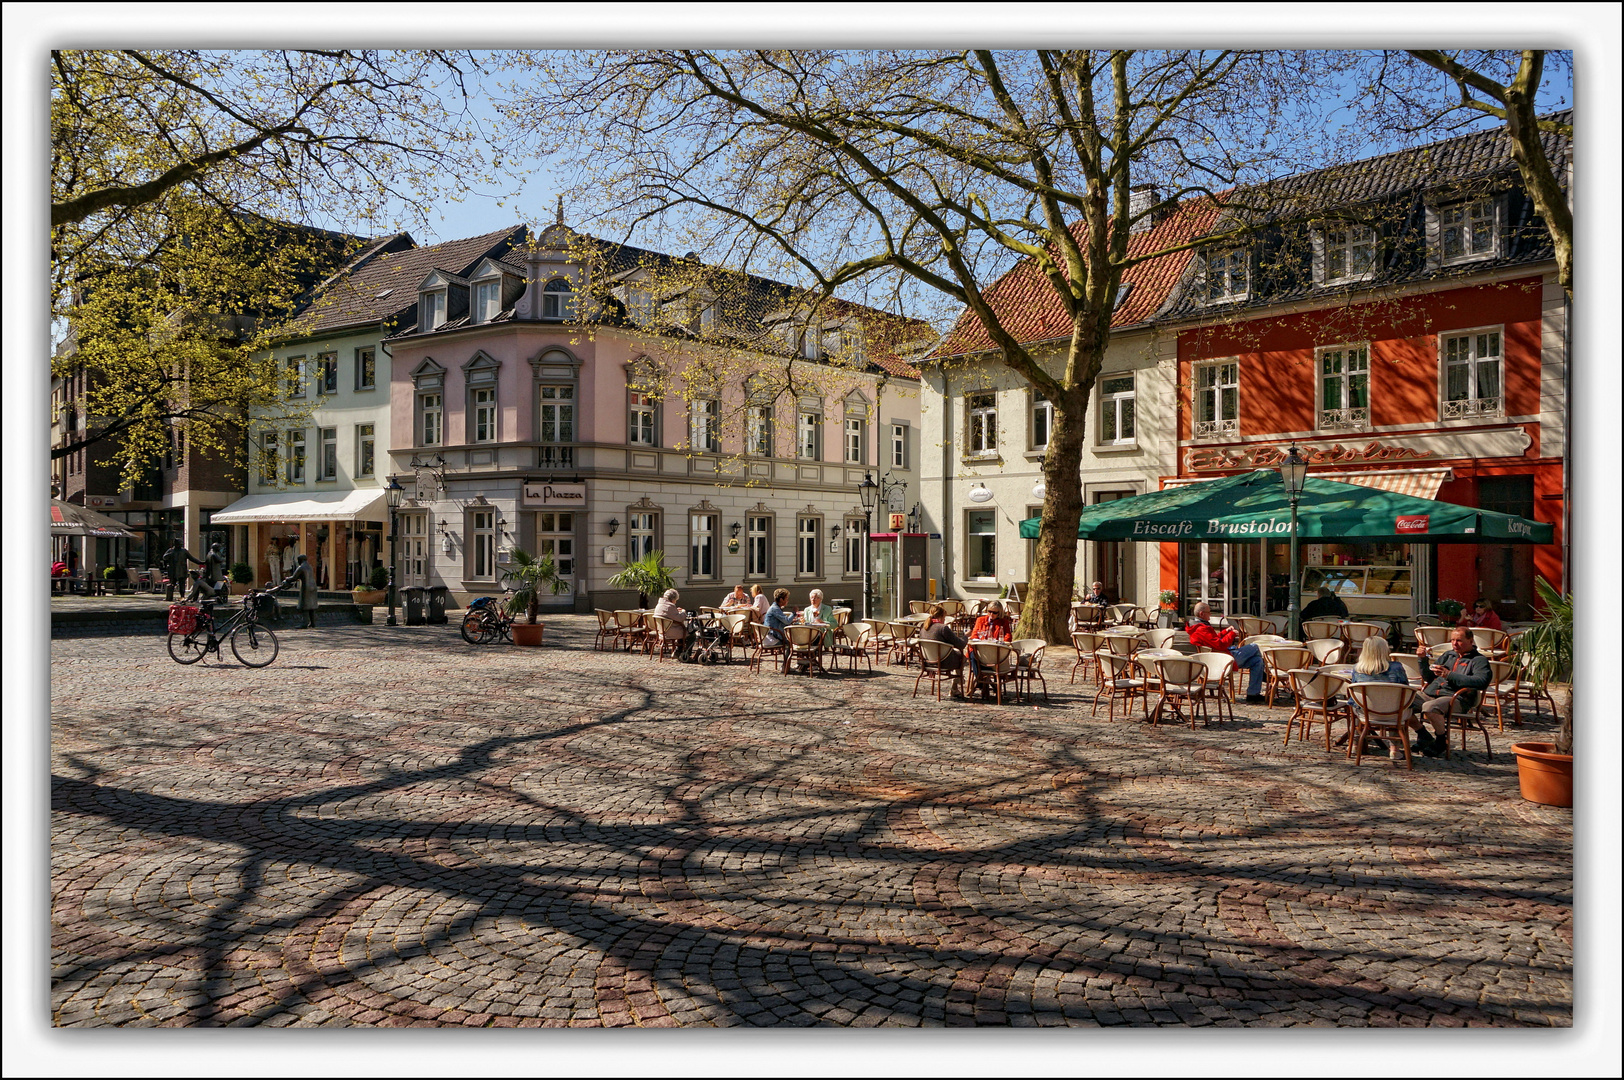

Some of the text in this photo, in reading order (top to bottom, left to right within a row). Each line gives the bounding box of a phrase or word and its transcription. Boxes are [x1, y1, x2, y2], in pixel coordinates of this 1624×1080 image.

[1244, 440, 1433, 467] Brstolon
[526, 486, 583, 503] La Piazza
[892, 515, 903, 528] T
[1133, 520, 1193, 537] Eiscafè
[435, 595, 445, 605] 10
